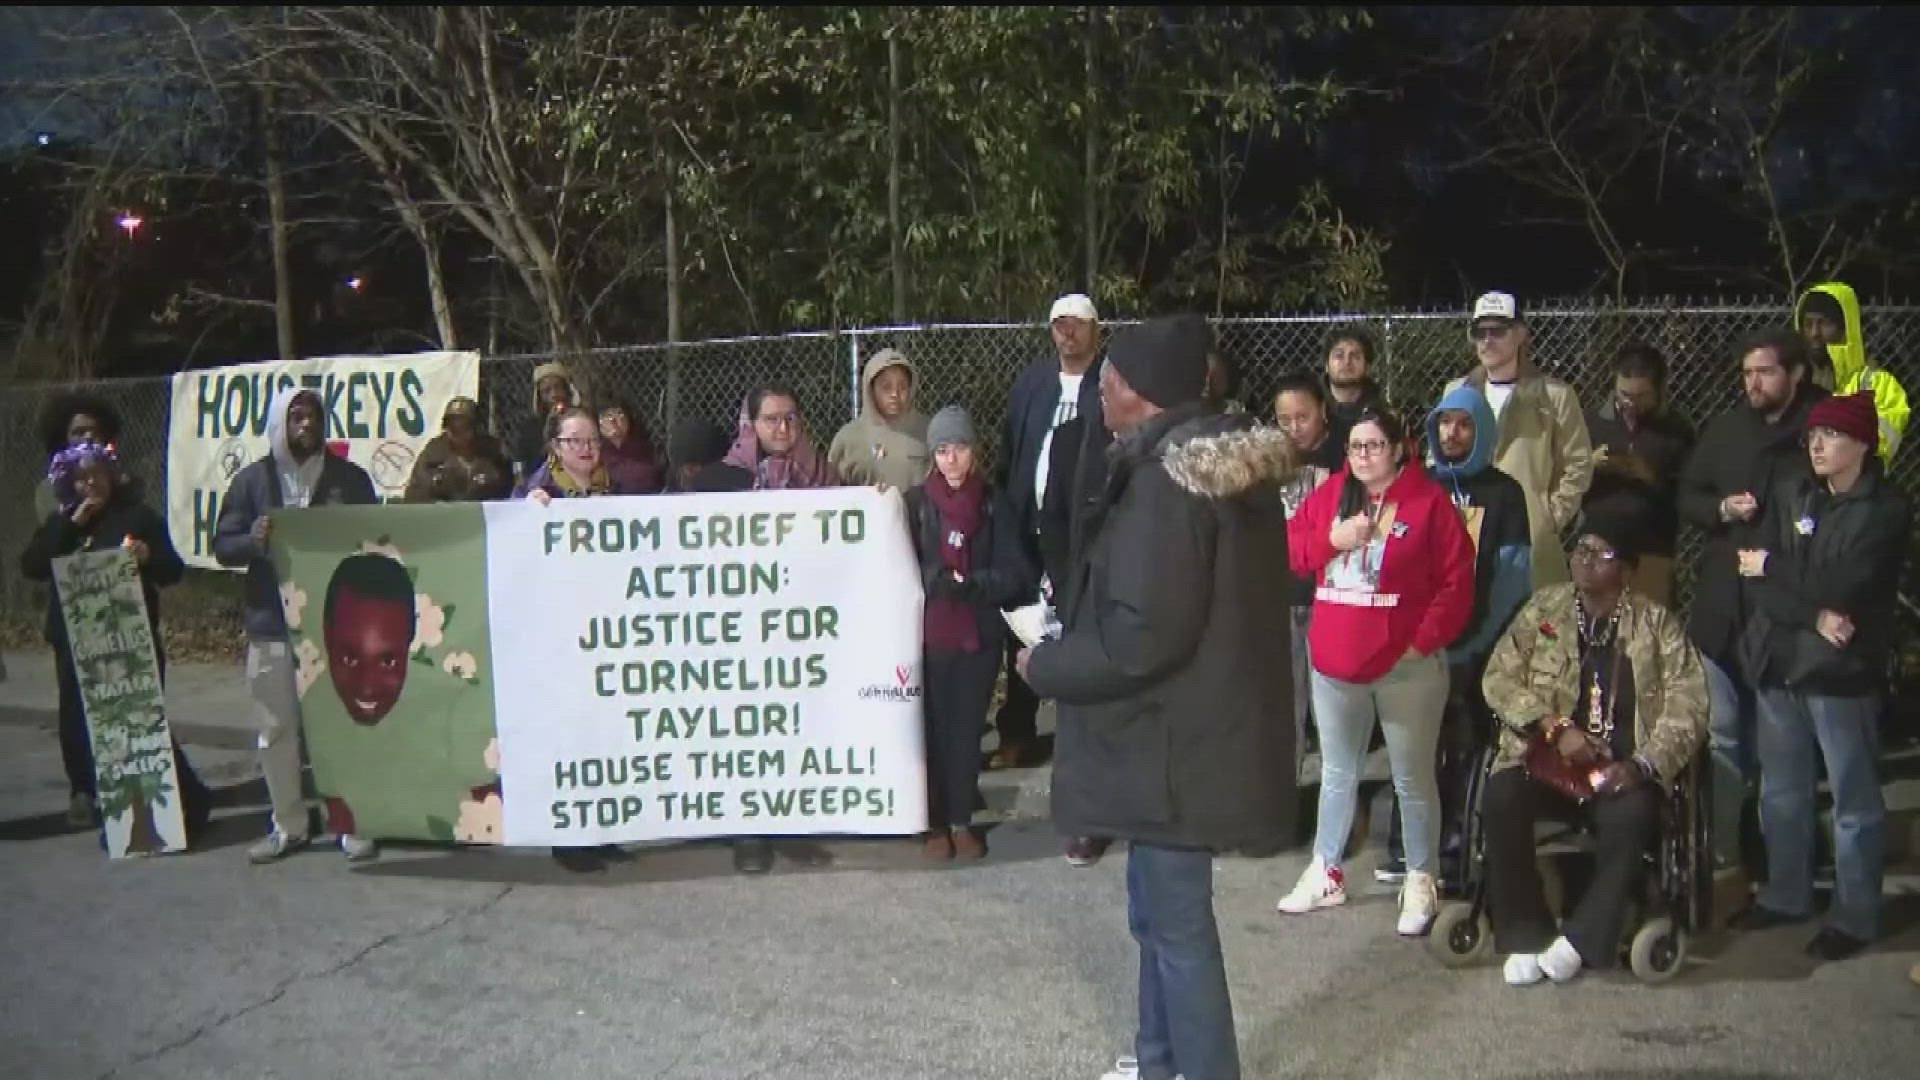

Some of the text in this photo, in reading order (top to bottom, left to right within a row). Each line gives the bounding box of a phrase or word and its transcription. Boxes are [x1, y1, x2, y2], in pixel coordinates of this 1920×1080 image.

[197, 368, 425, 439] HOU KEYS
[544, 510, 865, 555] FROM GRIEF TO
[626, 561, 790, 600] ACTION:
[578, 606, 839, 650] JUSTICE FOR
[596, 654, 828, 697] CORNELIUS
[626, 702, 800, 742] TAYLOR!
[555, 747, 875, 790] HOUSE THEM ALL!
[551, 785, 894, 829] STOP THE SWEEPS!
